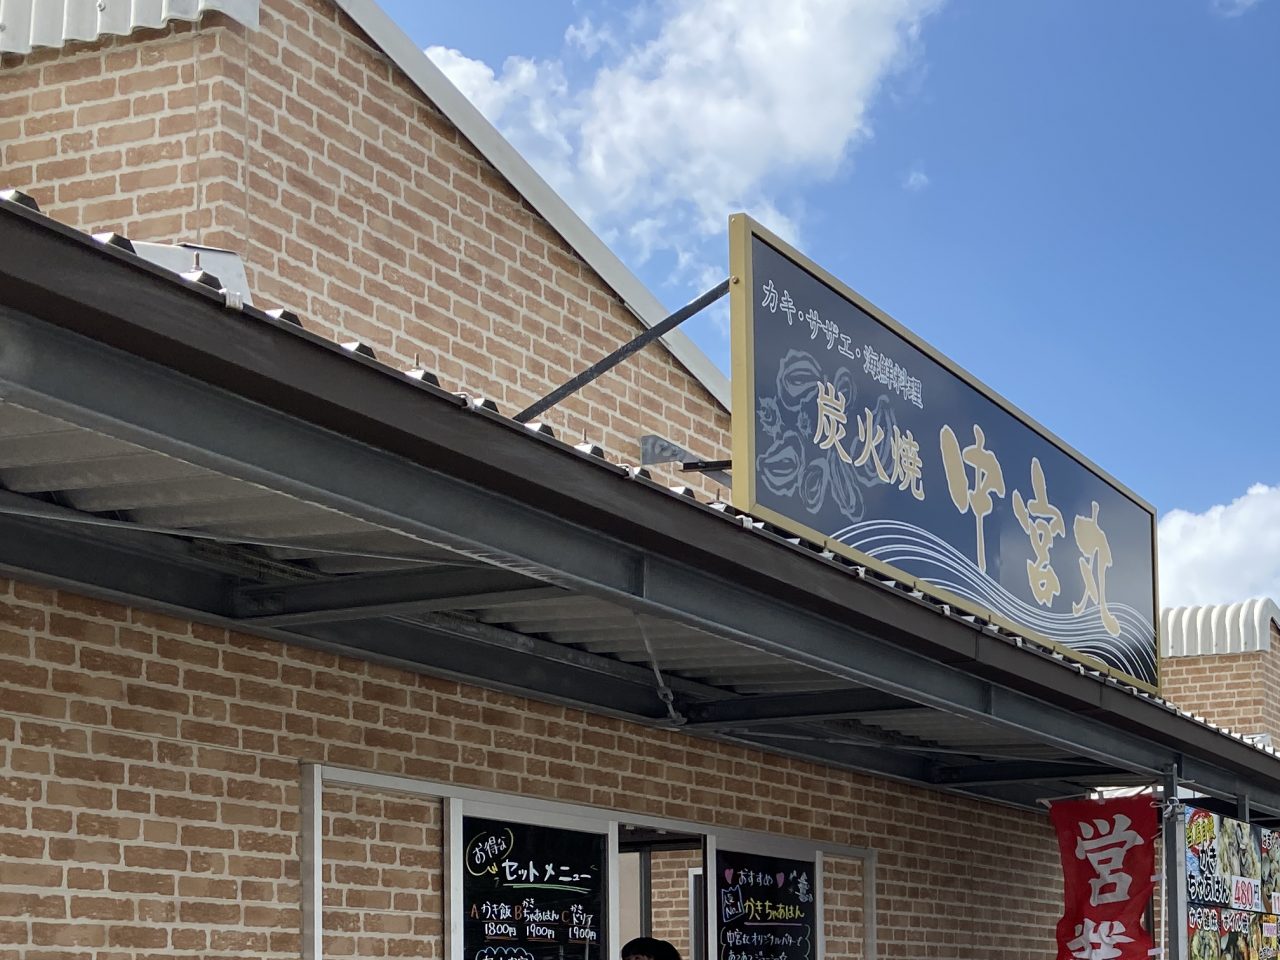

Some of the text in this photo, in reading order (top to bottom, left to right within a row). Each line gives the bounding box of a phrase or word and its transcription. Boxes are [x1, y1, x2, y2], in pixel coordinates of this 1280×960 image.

[813, 381, 925, 501] 炭火焼
[939, 424, 1121, 637] 中宮丸
[472, 836, 508, 864] お得な
[1199, 847, 1218, 873] かき
[502, 861, 592, 883] セットメニュー
[737, 868, 774, 887] おすすめ
[1187, 872, 1231, 904] ちゃあはん
[471, 901, 512, 920] A かき飯
[514, 904, 522, 921] B
[743, 897, 805, 920] かきちゃあはん
[572, 912, 594, 927] ドリア
[484, 923, 517, 938] 1800円
[526, 923, 555, 939] 1900円
[568, 926, 597, 941] 1900円
